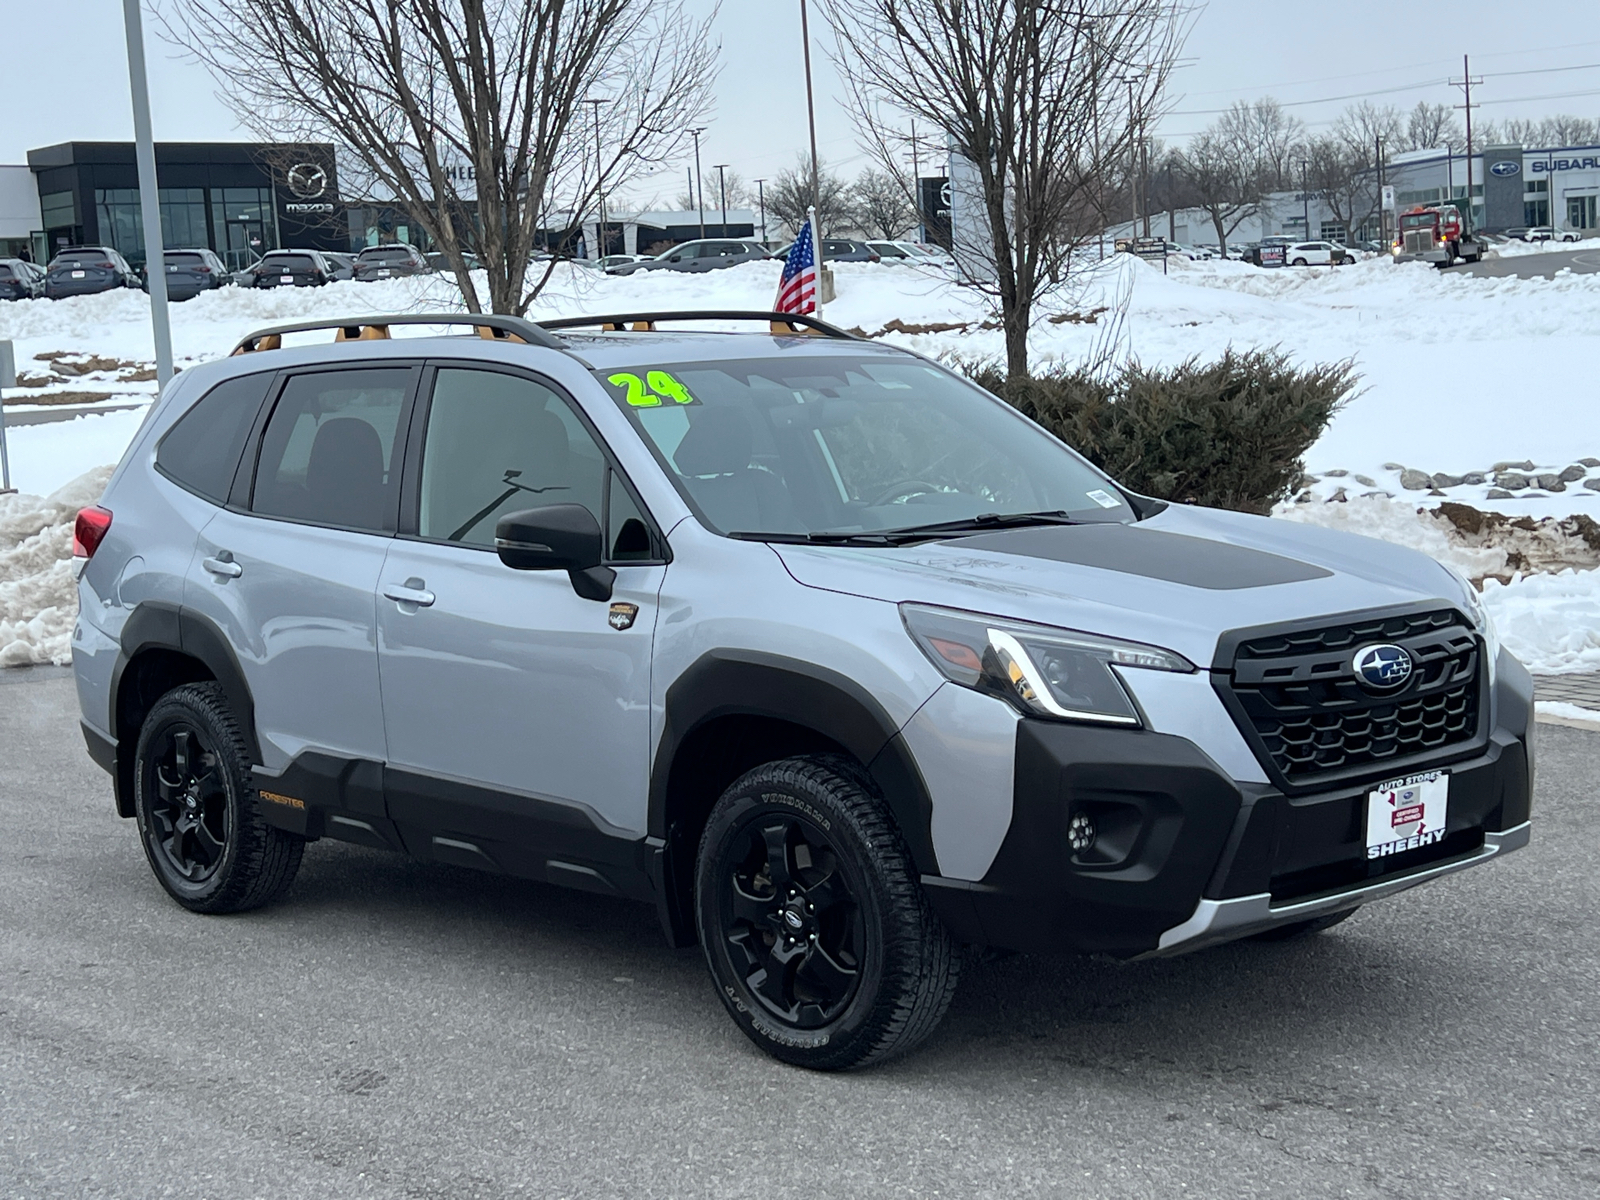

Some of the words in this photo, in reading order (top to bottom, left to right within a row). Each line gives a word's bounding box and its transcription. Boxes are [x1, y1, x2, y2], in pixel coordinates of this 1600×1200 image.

[441, 166, 477, 180] HEE
[607, 370, 693, 408] 24
[1378, 779, 1403, 792] AUTO
[1406, 771, 1442, 785] STORES
[259, 790, 306, 810] FORESTER
[761, 792, 831, 831] YOKOHAMA
[1368, 829, 1445, 859] SHEEHY
